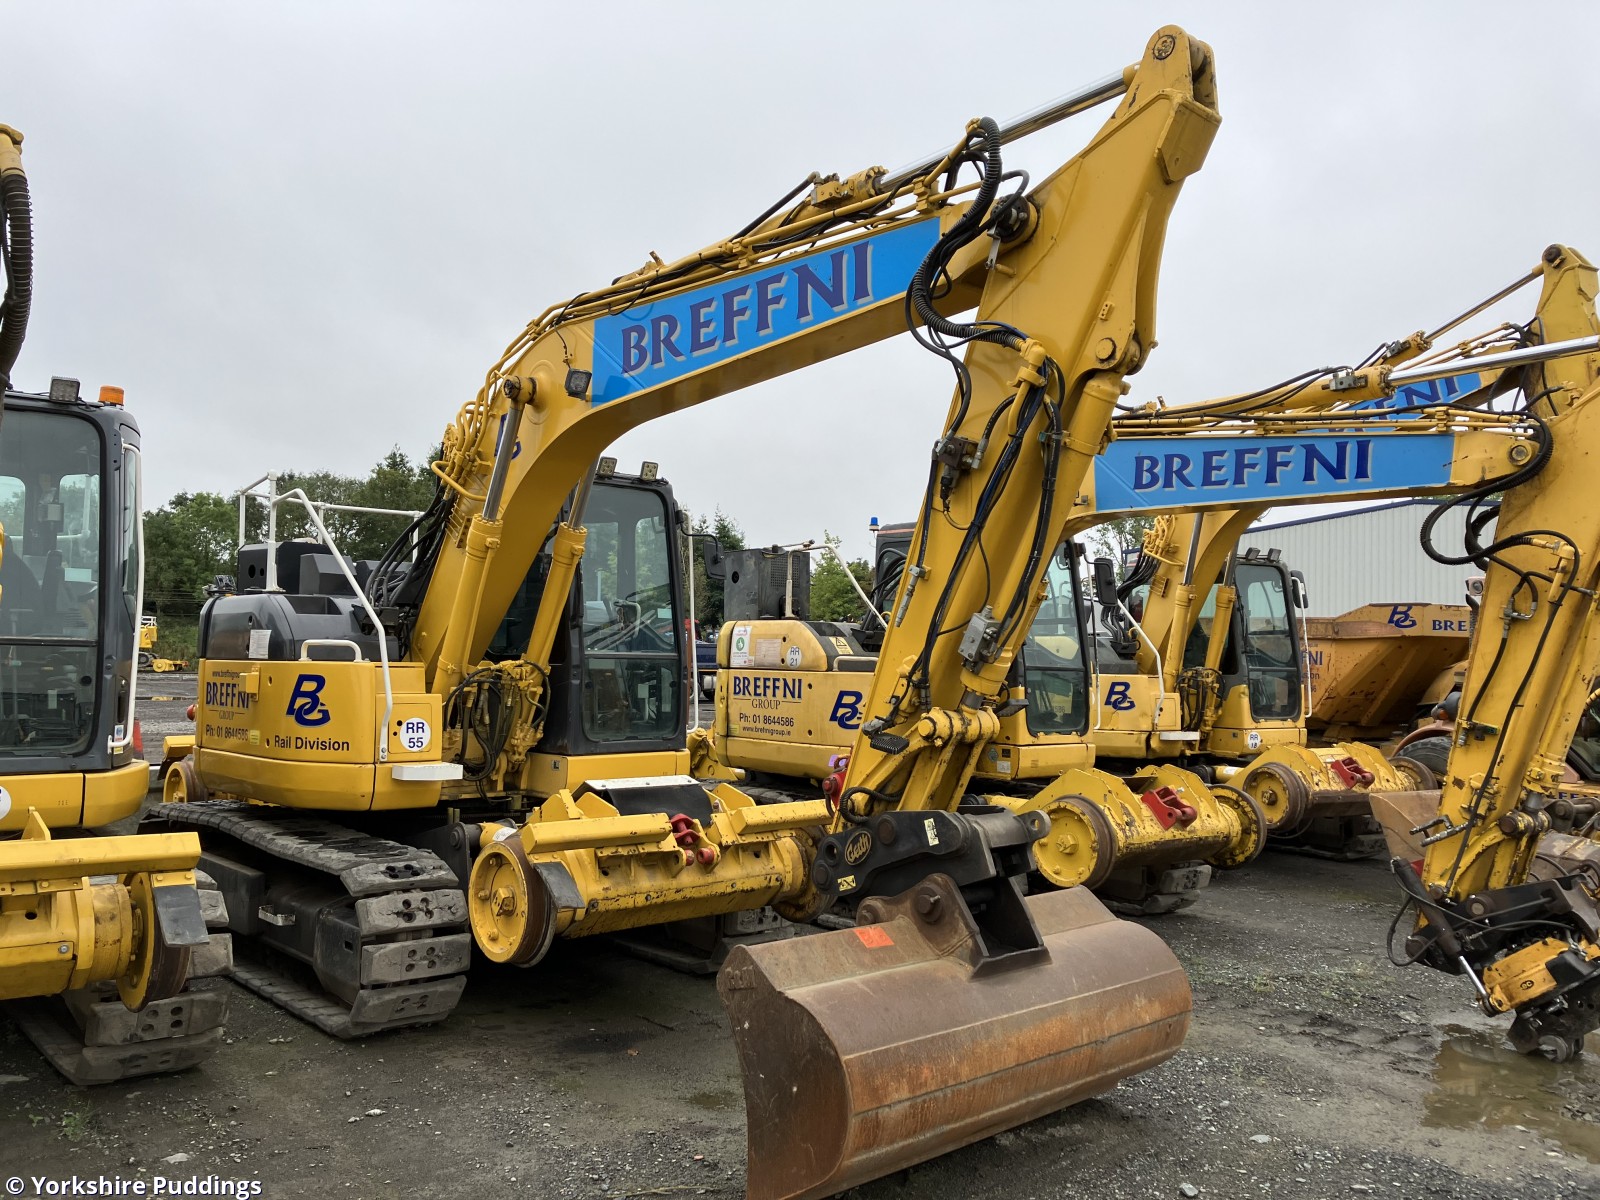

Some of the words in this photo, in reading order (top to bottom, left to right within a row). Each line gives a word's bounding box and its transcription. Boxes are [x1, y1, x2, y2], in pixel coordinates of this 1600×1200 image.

[621, 241, 873, 377] BREFFNI
[1133, 440, 1374, 492] BREFFNI
[1432, 619, 1468, 632] BRE
[789, 658, 799, 666] 21
[733, 676, 802, 699] BREFFNI
[286, 674, 331, 727] BG
[1104, 681, 1136, 711] BG
[752, 699, 781, 709] GROUP
[219, 711, 235, 720] GROUP
[740, 712, 751, 722] Ph:
[752, 713, 761, 724] 01
[763, 714, 795, 727] 8644586
[205, 724, 215, 736] Ph:
[216, 725, 223, 738] 01
[224, 726, 249, 741] 8644586
[406, 721, 425, 734] RR
[274, 735, 292, 749] Rail
[295, 737, 350, 751] Division
[408, 737, 424, 749] 55
